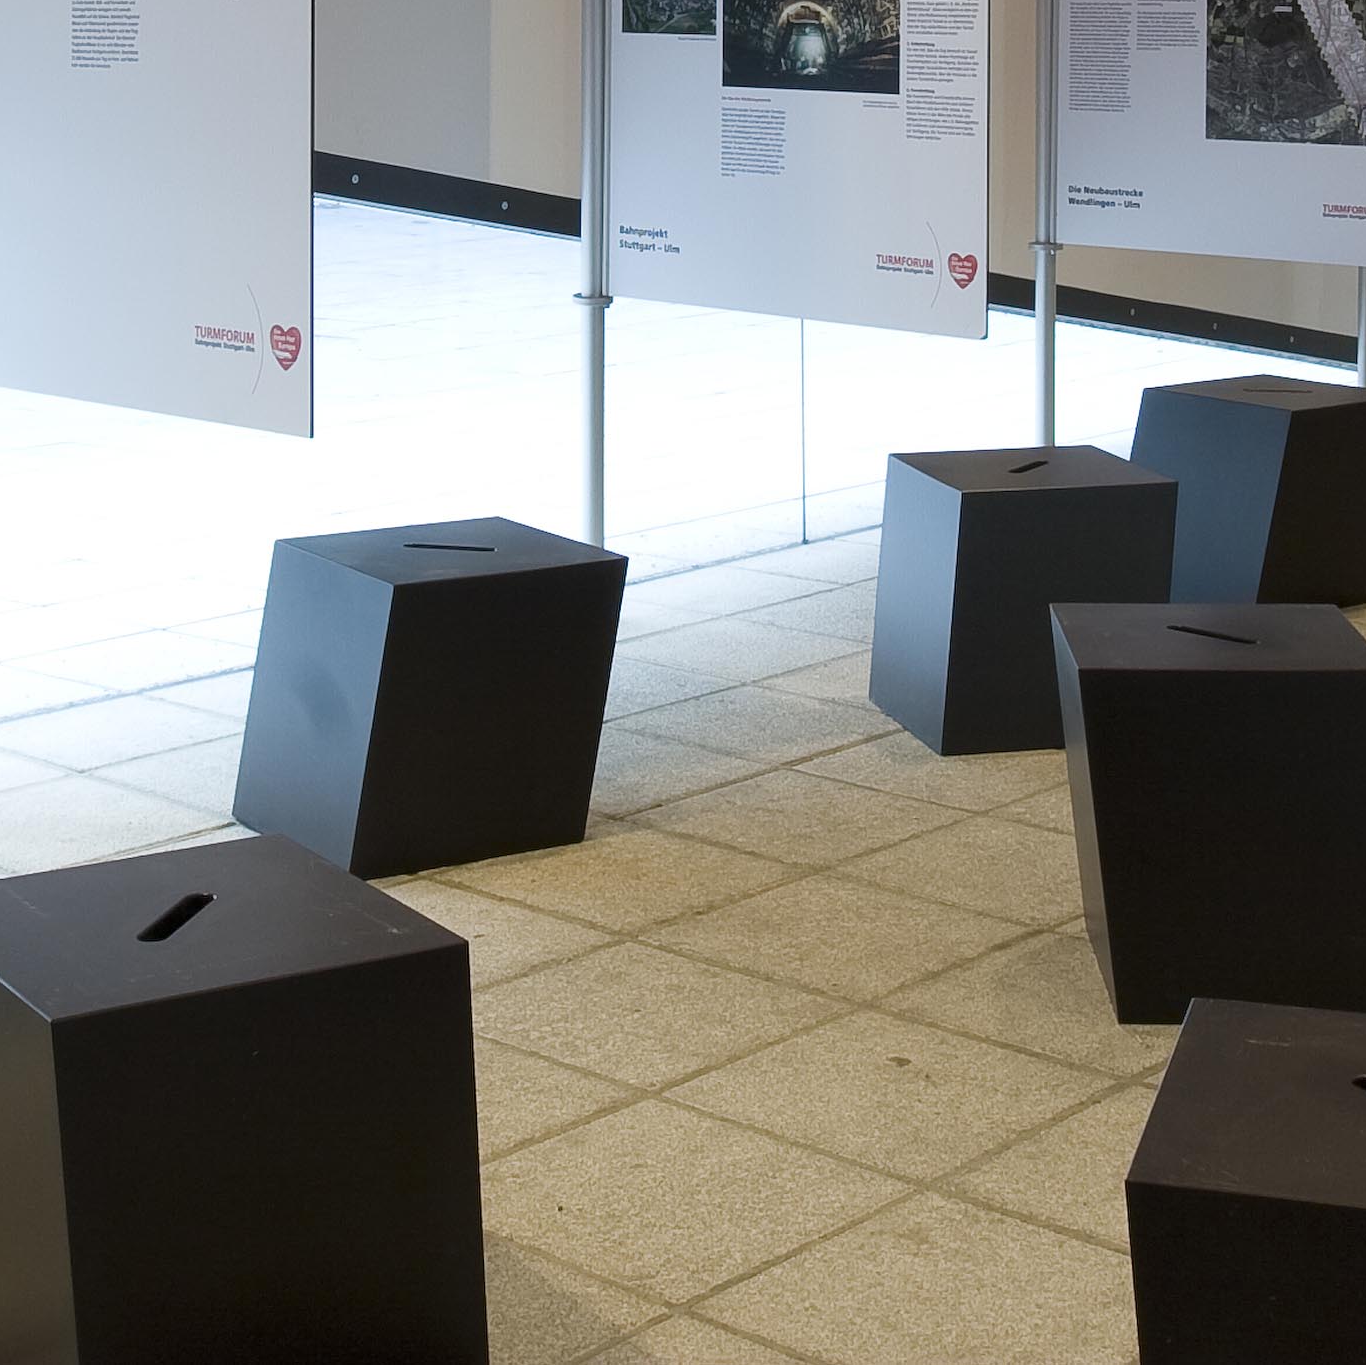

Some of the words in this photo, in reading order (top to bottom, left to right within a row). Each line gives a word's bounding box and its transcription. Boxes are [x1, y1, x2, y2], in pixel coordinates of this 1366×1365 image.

[1067, 185, 1082, 194] Die
[1083, 186, 1143, 197] Neubaustrecke
[1067, 196, 1116, 208] Wendlingen
[1124, 200, 1141, 209] Ulm
[619, 225, 668, 240] Bahnprojekt
[619, 239, 656, 253] Stuttgart
[664, 243, 681, 254] Ulm
[875, 254, 935, 270] TURMFORUM
[194, 325, 256, 345] TURMFORUM
